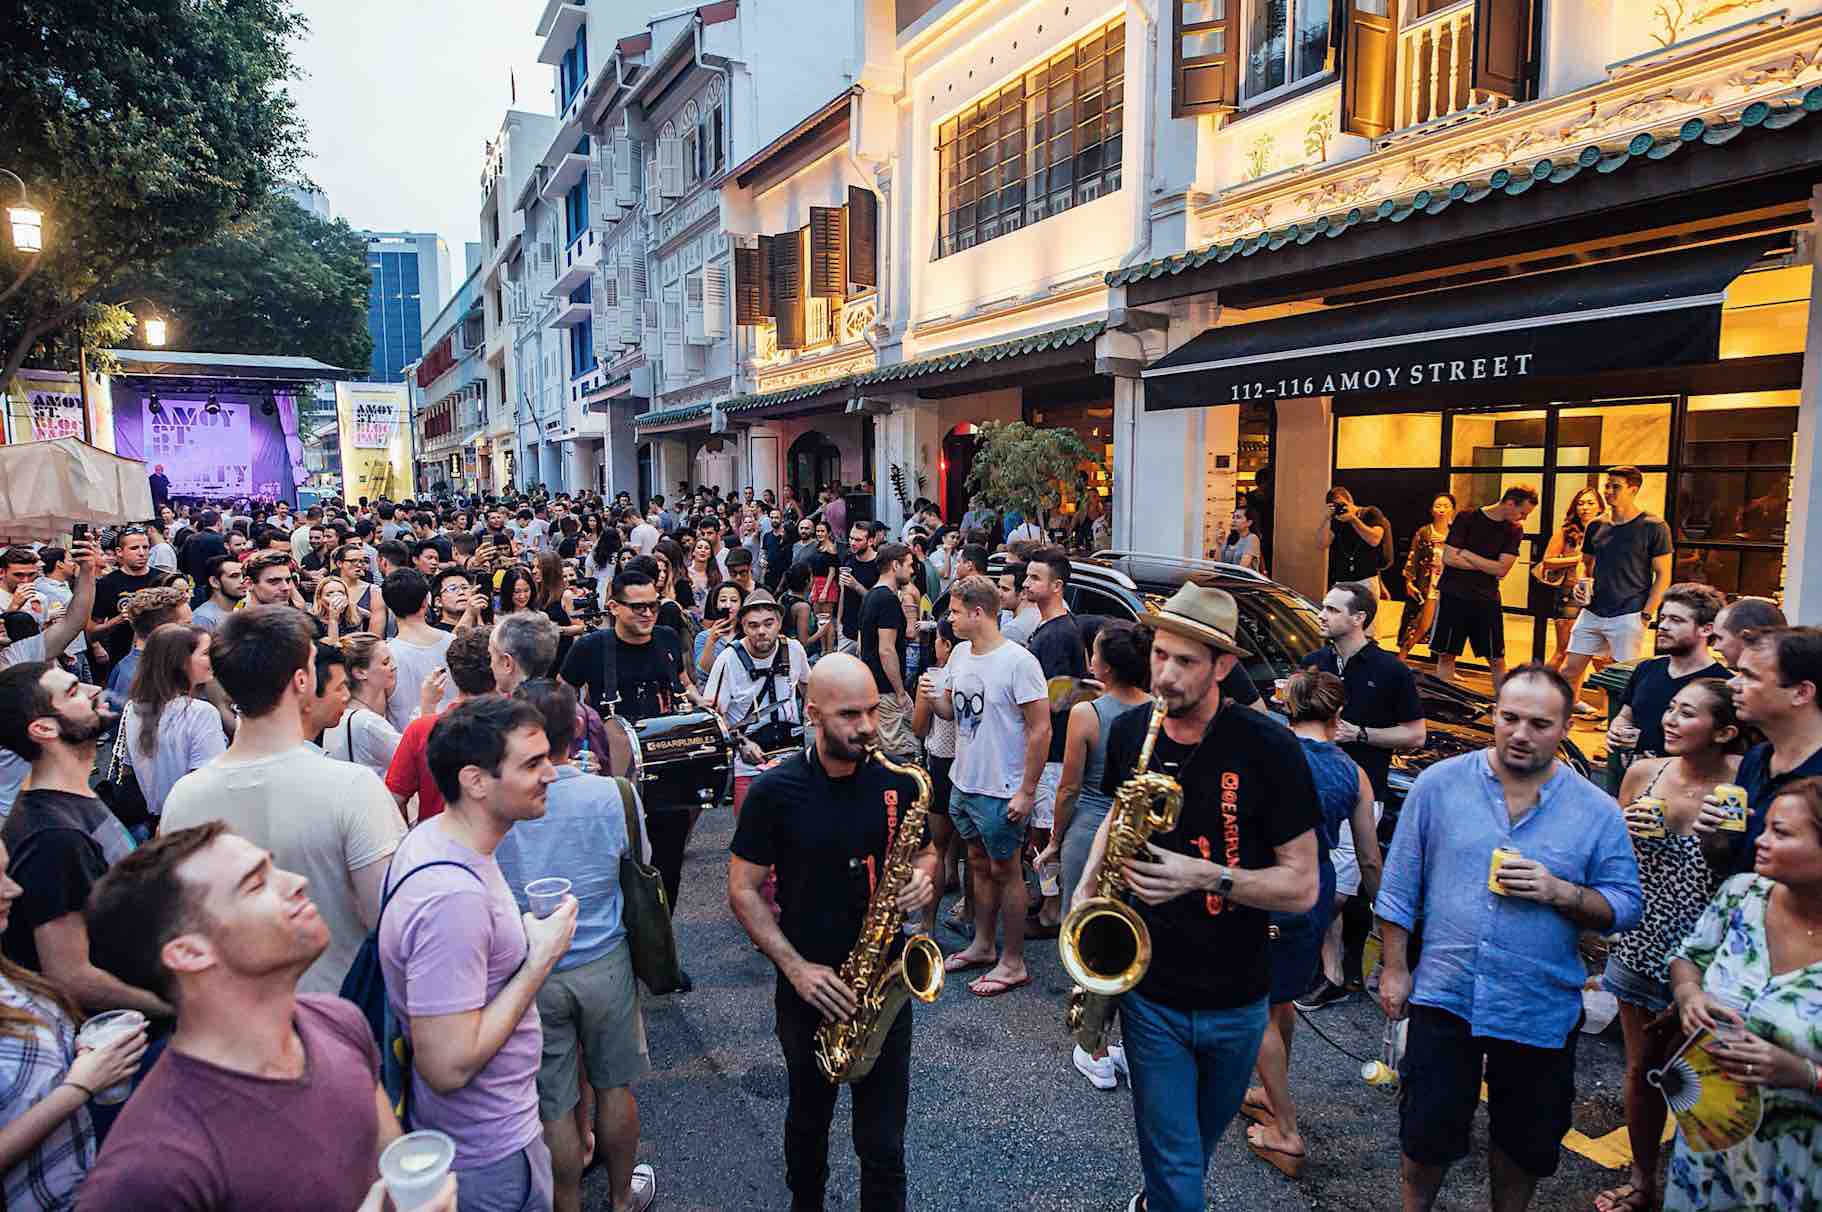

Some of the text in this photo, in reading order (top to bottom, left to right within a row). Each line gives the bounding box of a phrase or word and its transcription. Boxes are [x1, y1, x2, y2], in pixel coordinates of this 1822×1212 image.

[1231, 354, 1533, 400] 112-116 AMOY STREET
[356, 403, 394, 415] AMOY
